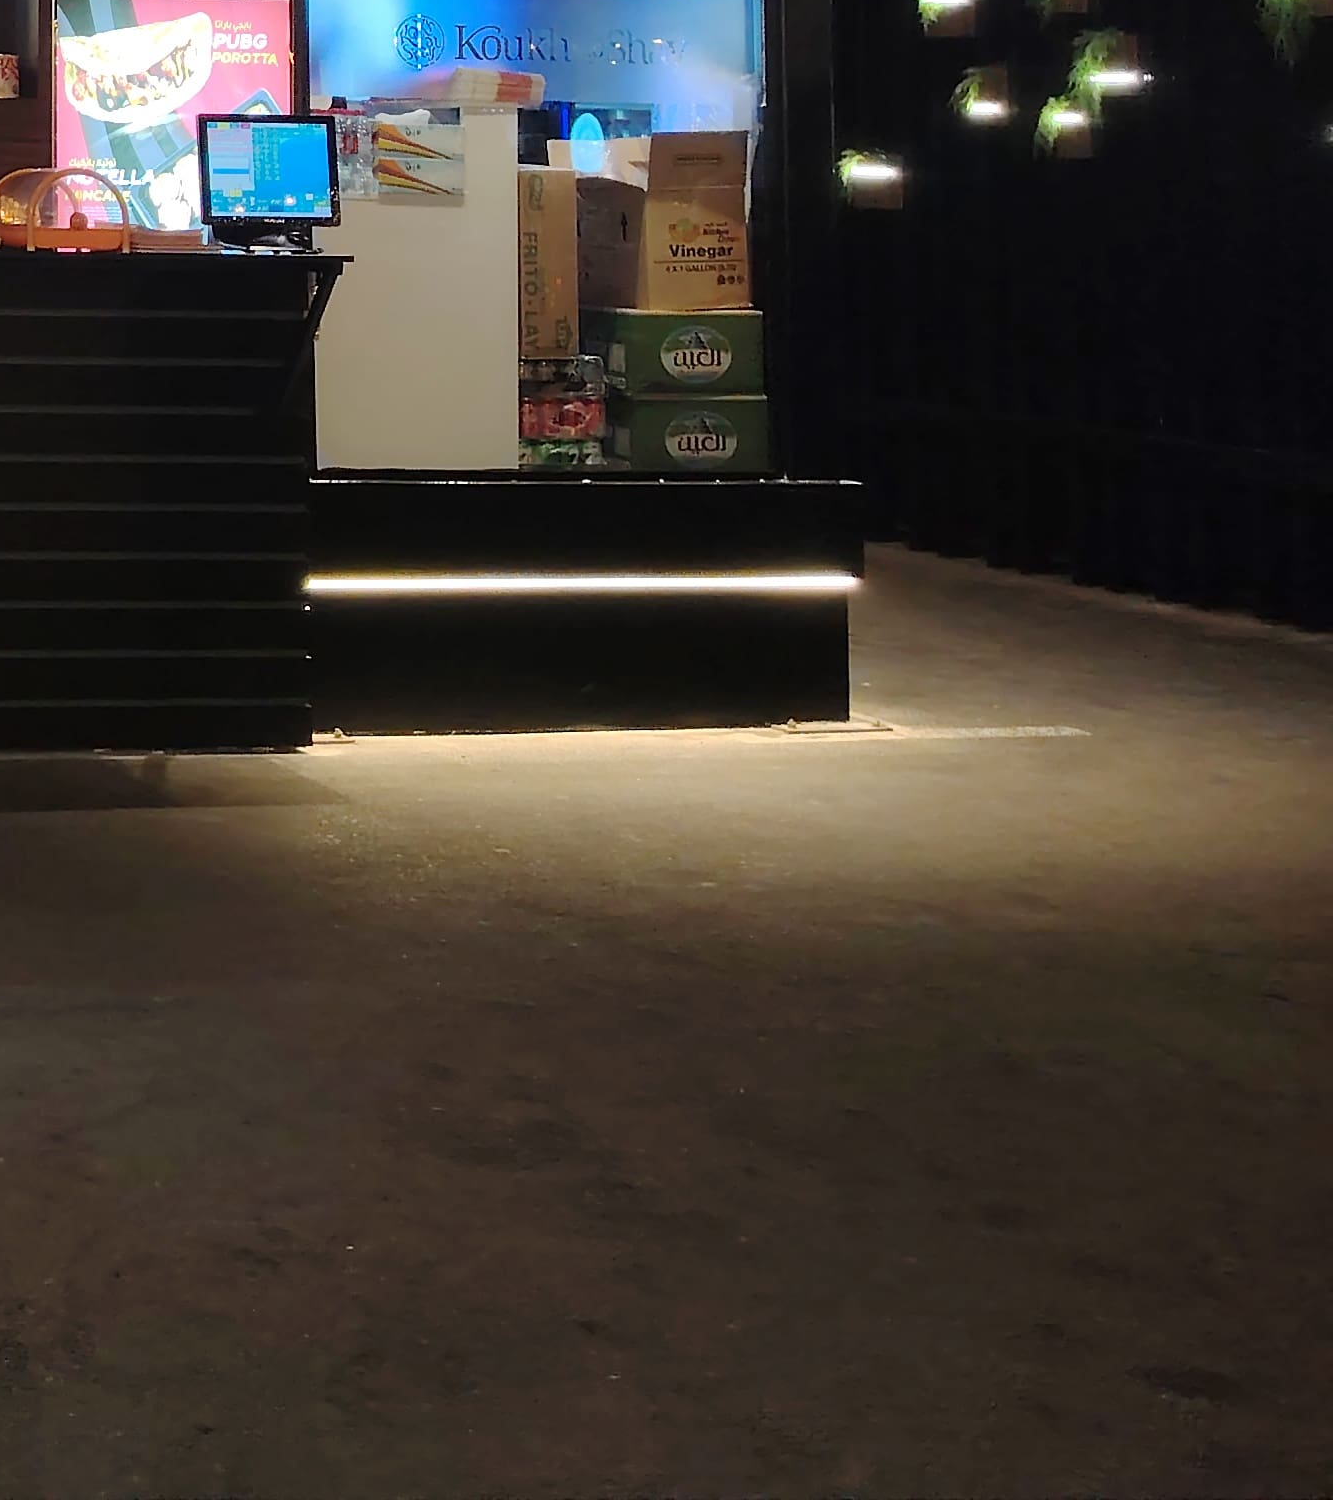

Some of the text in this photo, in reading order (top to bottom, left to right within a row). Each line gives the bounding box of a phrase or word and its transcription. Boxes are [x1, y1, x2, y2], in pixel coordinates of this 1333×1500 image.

[212, 32, 268, 50] PUBG
[454, 25, 571, 62] Koukh
[211, 51, 278, 66] POROTTA
[65, 190, 132, 203] NCAE
[668, 244, 734, 259] Vinegar
